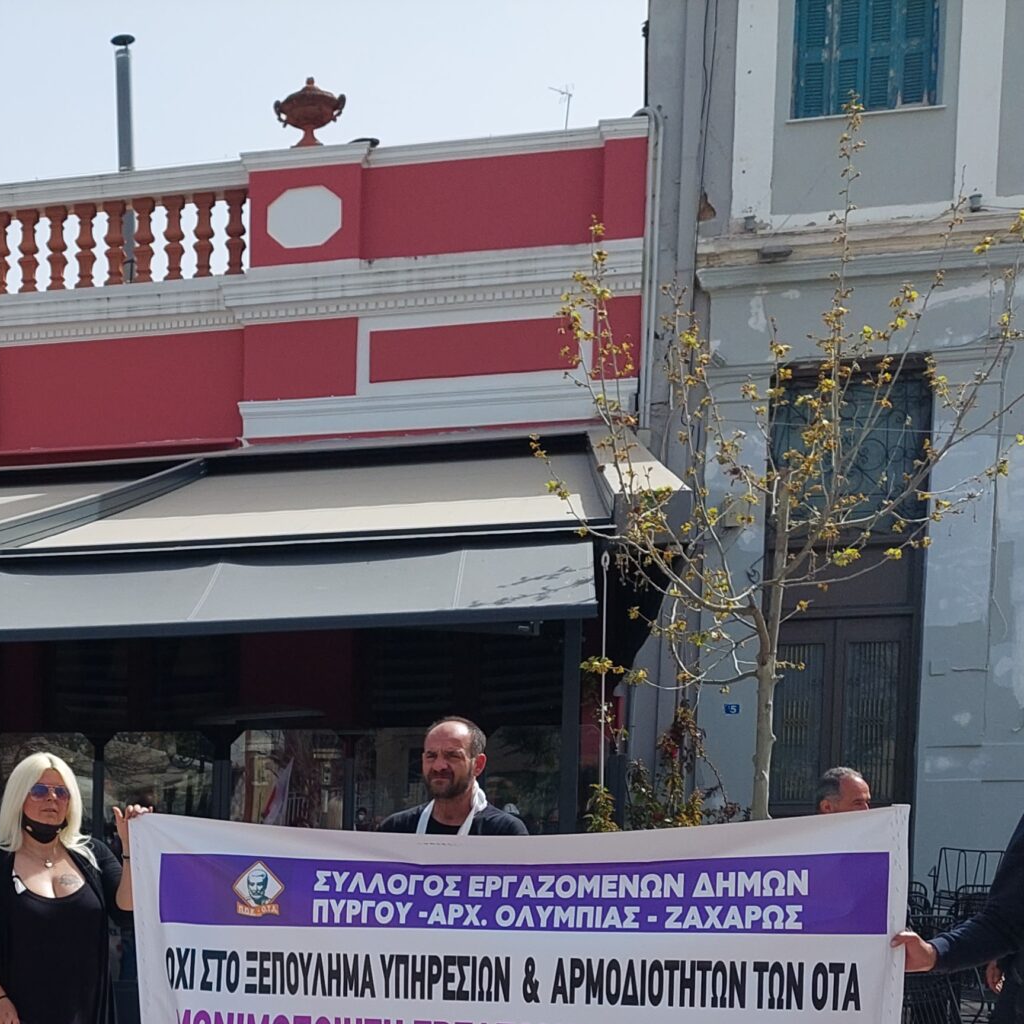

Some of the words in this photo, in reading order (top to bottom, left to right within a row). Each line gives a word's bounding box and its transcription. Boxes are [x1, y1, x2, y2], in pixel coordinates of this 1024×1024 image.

[314, 870, 461, 897] ΣΥΛΛΟΓΟΣ
[468, 872, 685, 899] ΕΡΓΑΖΟΜΕΝΩΝ
[693, 869, 809, 898] ΔΗΜΩΝ
[313, 899, 411, 925] ΠΥΡΓΟΥ
[418, 903, 487, 926] -ΑΡΧ.
[495, 904, 640, 929] ΟΛΥΜΠΙΑΣ
[665, 905, 803, 930] ΖΑΧΑΡΩΣ
[166, 947, 194, 991] ΟΧΙ
[200, 950, 240, 994] ΣΤΟ
[245, 951, 375, 998] ΞΕΠΟΥΛΗΜΑ
[380, 955, 510, 1002] ΥΠΗΡΕΣΙΩΝ
[522, 957, 540, 1003] &
[551, 957, 747, 1009] ΑΡΜΟΔΙΟΤΗΤΩΝ
[753, 961, 805, 1010] ΤΩΝ
[812, 962, 861, 1011] ΟΤΑ
